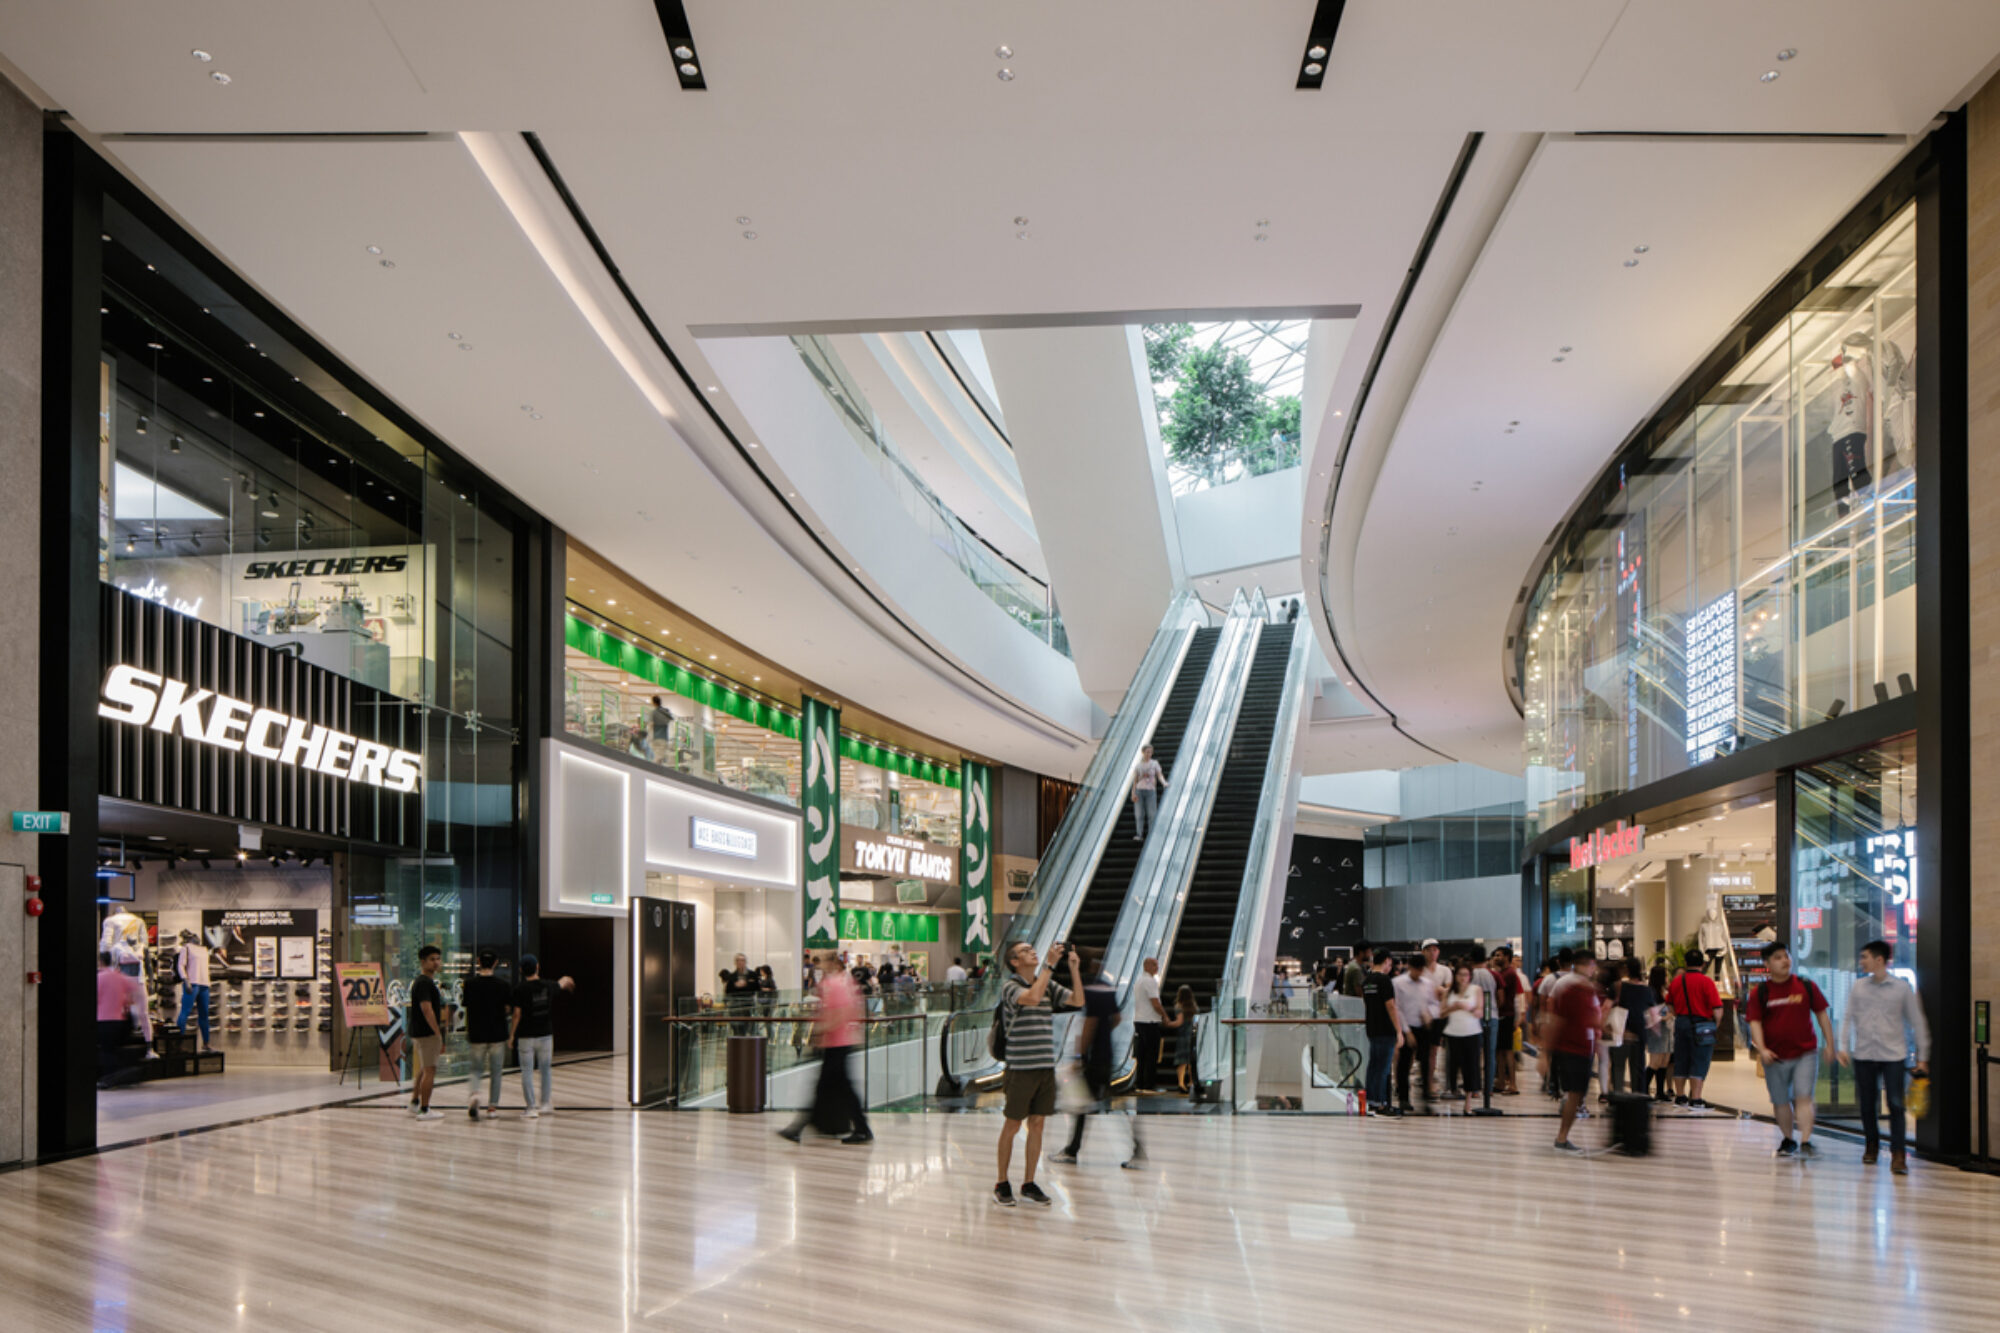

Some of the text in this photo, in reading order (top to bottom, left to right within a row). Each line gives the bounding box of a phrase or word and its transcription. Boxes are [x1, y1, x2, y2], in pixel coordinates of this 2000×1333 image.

[244, 555, 408, 580] SKECHERS
[97, 663, 423, 794] SKECHERS
[22, 813, 51, 829] EXIT
[807, 726, 837, 940] ハンズ
[855, 840, 952, 882] TOKYU HANDS
[965, 780, 991, 946] ハンズ
[1311, 1046, 1363, 1089] L2
